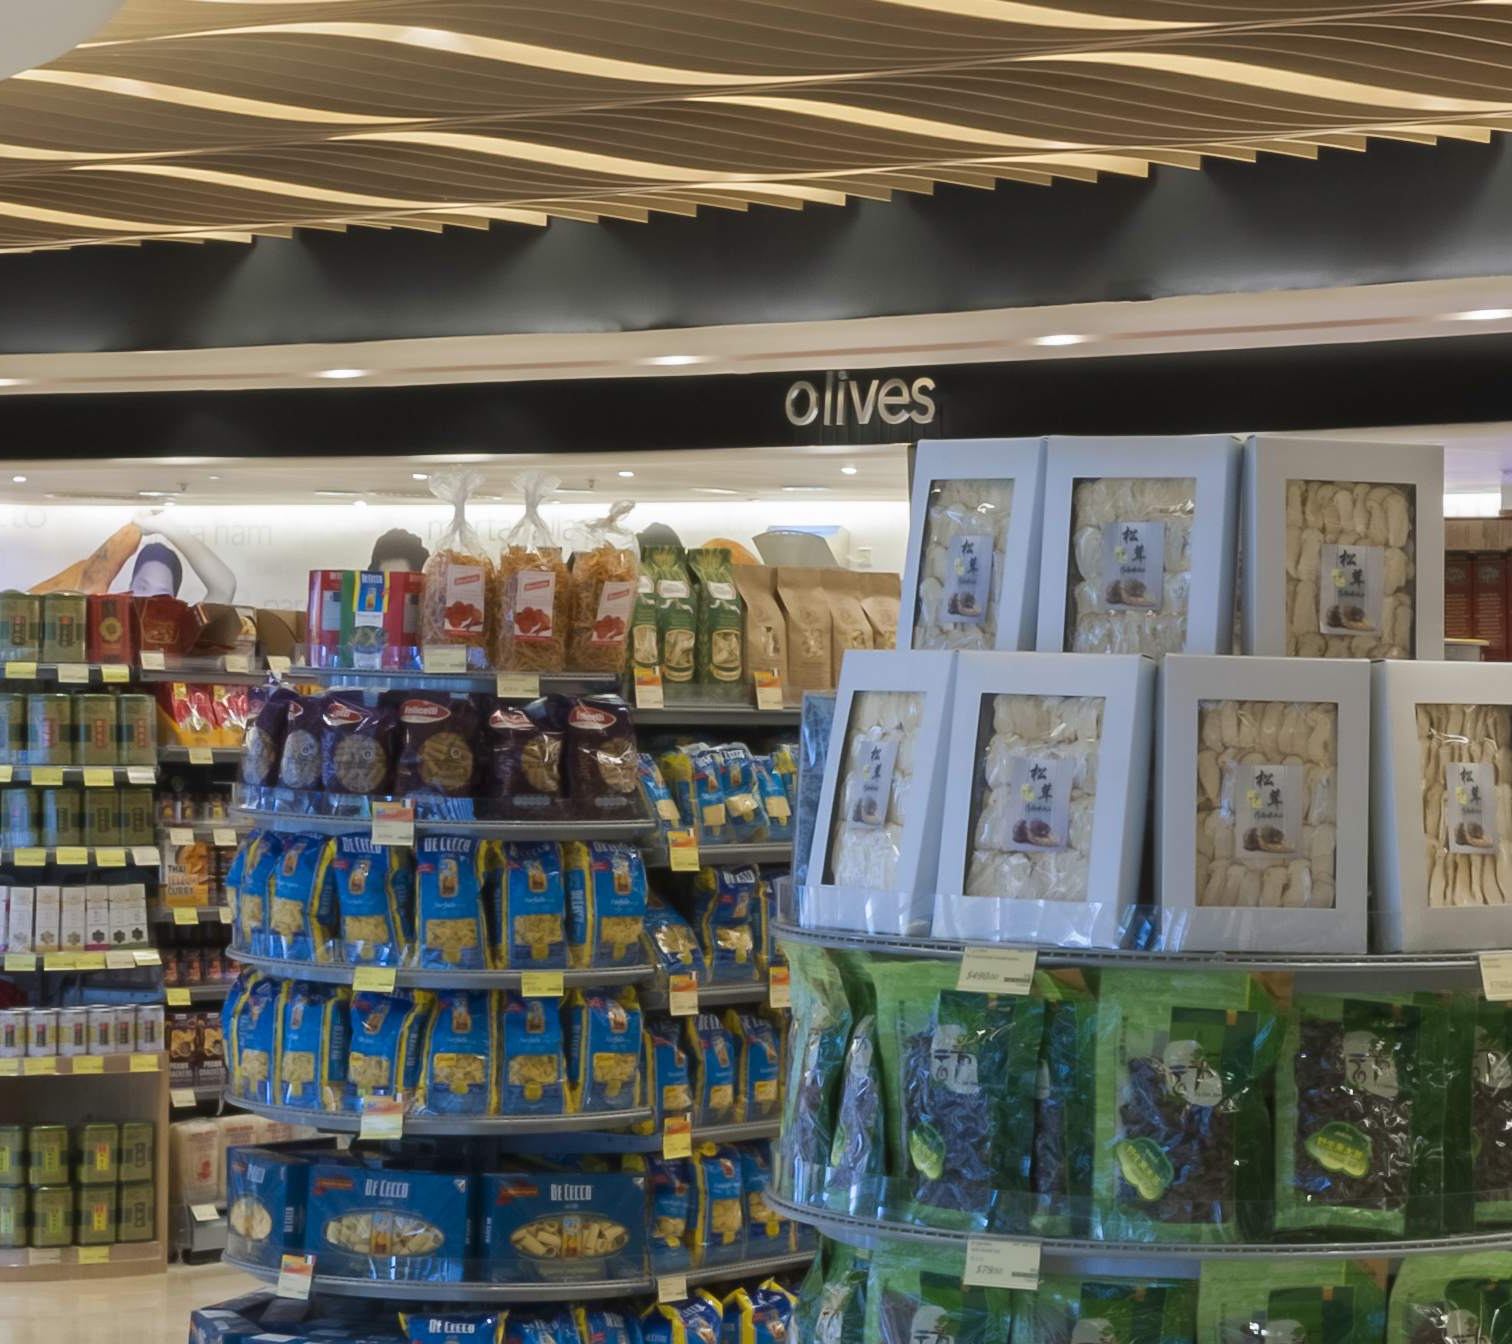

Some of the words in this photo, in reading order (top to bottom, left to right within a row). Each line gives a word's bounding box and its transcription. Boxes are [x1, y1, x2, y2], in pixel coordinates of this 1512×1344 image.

[785, 371, 936, 426] olives
[404, 704, 439, 717] felicetti
[424, 837, 438, 852] DE
[167, 886, 194, 896] CURRY
[966, 970, 999, 981] $490.00
[364, 1178, 378, 1197] DE
[378, 1179, 410, 1199] CECCO
[550, 1183, 563, 1201] DE
[564, 1184, 593, 1201] CECCO
[976, 1264, 1003, 1275] $79.50
[429, 1318, 443, 1333] DE
[444, 1322, 476, 1334] CECCO
